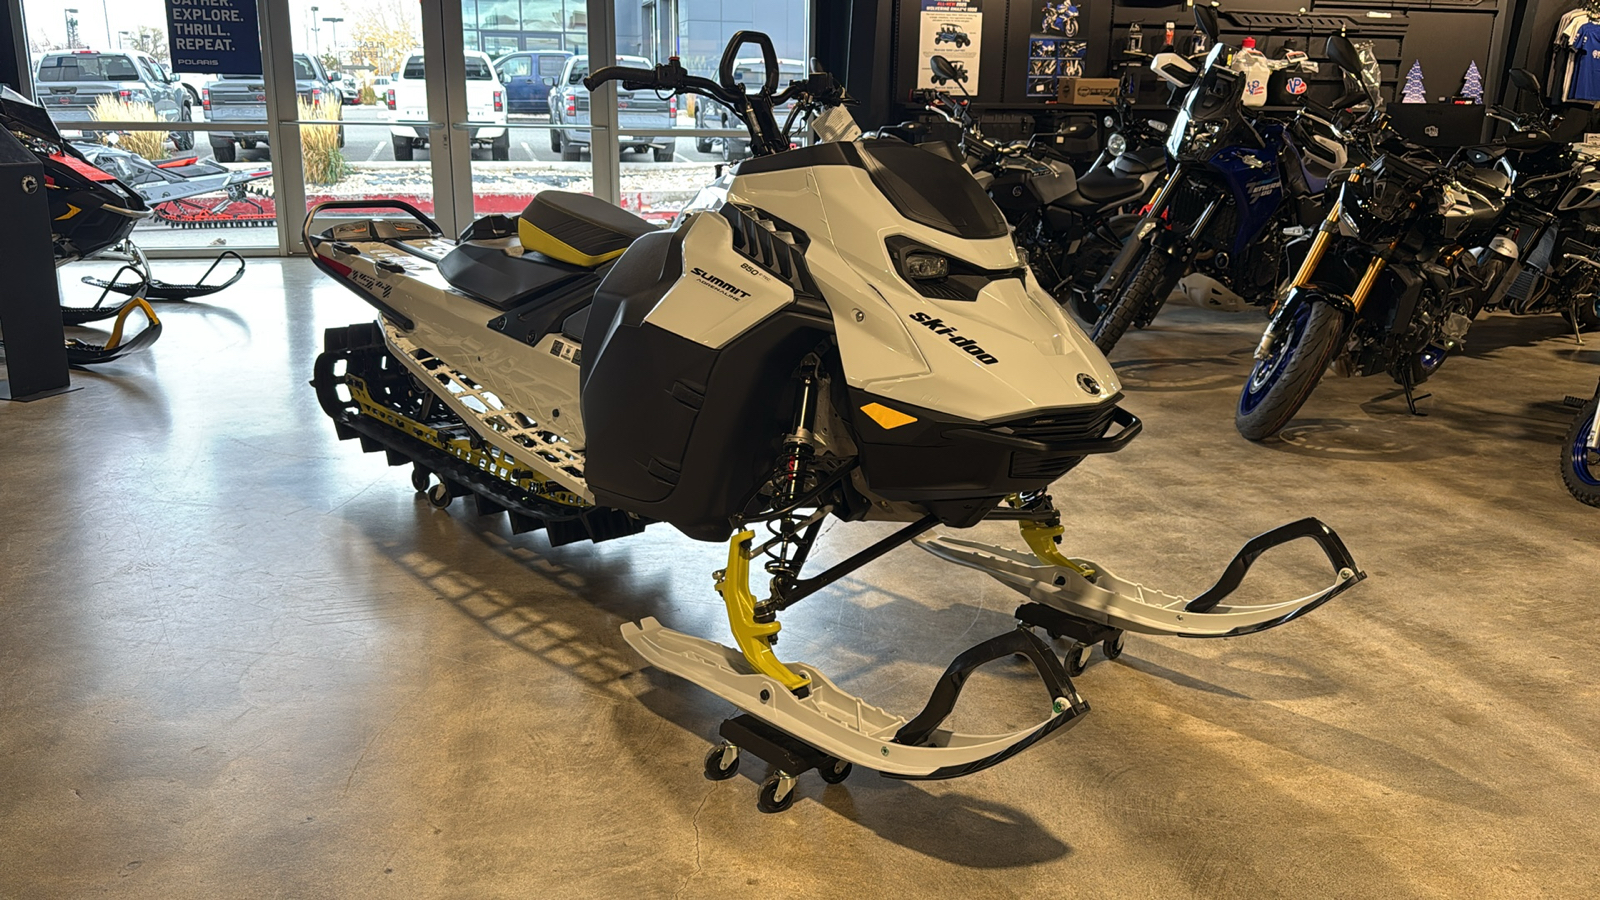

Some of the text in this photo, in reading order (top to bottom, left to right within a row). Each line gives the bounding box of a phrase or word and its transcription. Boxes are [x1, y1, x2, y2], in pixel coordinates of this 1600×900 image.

[172, 8, 244, 22] EXPLORE.
[174, 23, 231, 36] THRILL.
[176, 38, 236, 51] REPEAT.
[1288, 77, 1303, 93] VP
[740, 262, 760, 276] 850
[690, 267, 752, 298] SUMMIT
[696, 278, 741, 302] ADRENALINE
[908, 311, 999, 365] ski-doo
